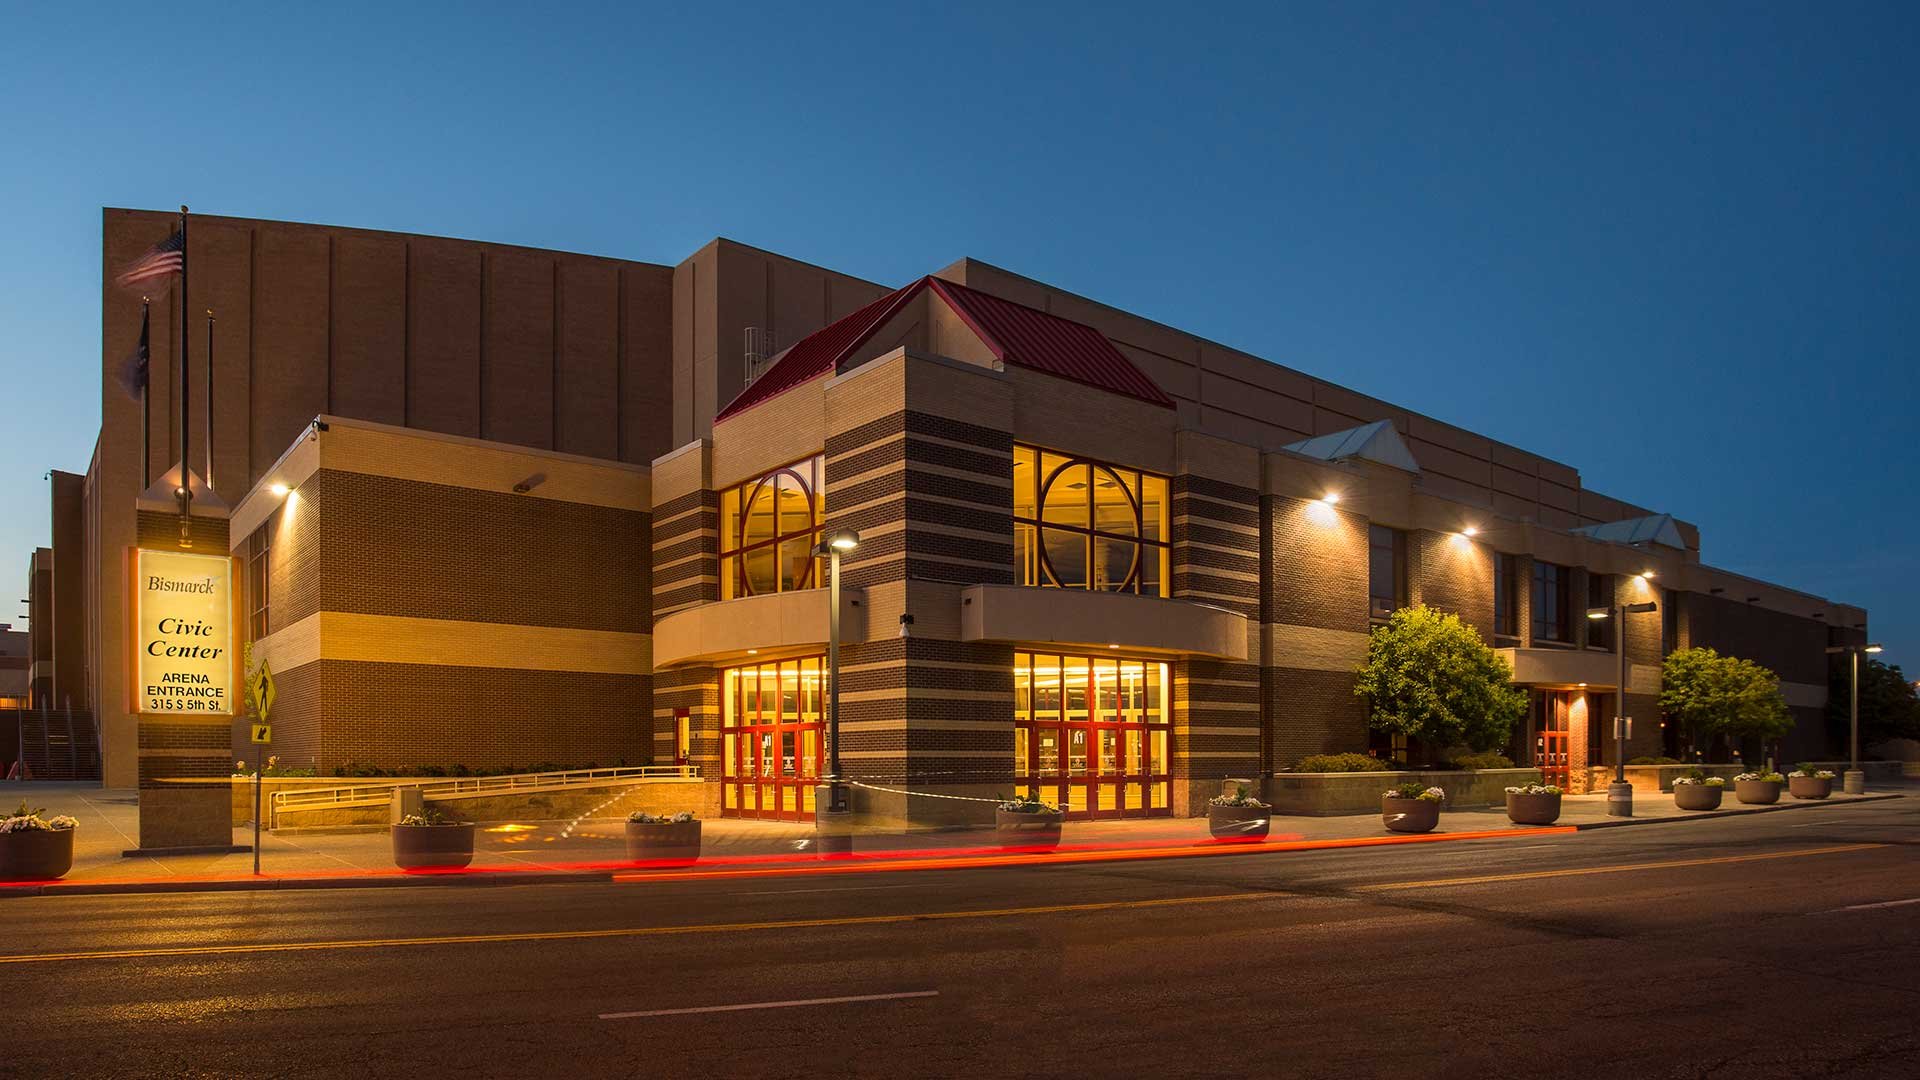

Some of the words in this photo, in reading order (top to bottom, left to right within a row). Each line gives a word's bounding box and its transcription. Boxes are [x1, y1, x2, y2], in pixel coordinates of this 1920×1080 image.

[147, 575, 214, 594] Bismarck
[158, 617, 213, 636] Civic
[147, 640, 223, 659] Center
[161, 672, 210, 684] ARENA
[147, 685, 224, 697] ENTRANCE
[151, 698, 173, 710] 315
[176, 699, 183, 710] S
[187, 699, 205, 710] 5th
[208, 700, 221, 711] St.
[1073, 731, 1083, 744] A1
